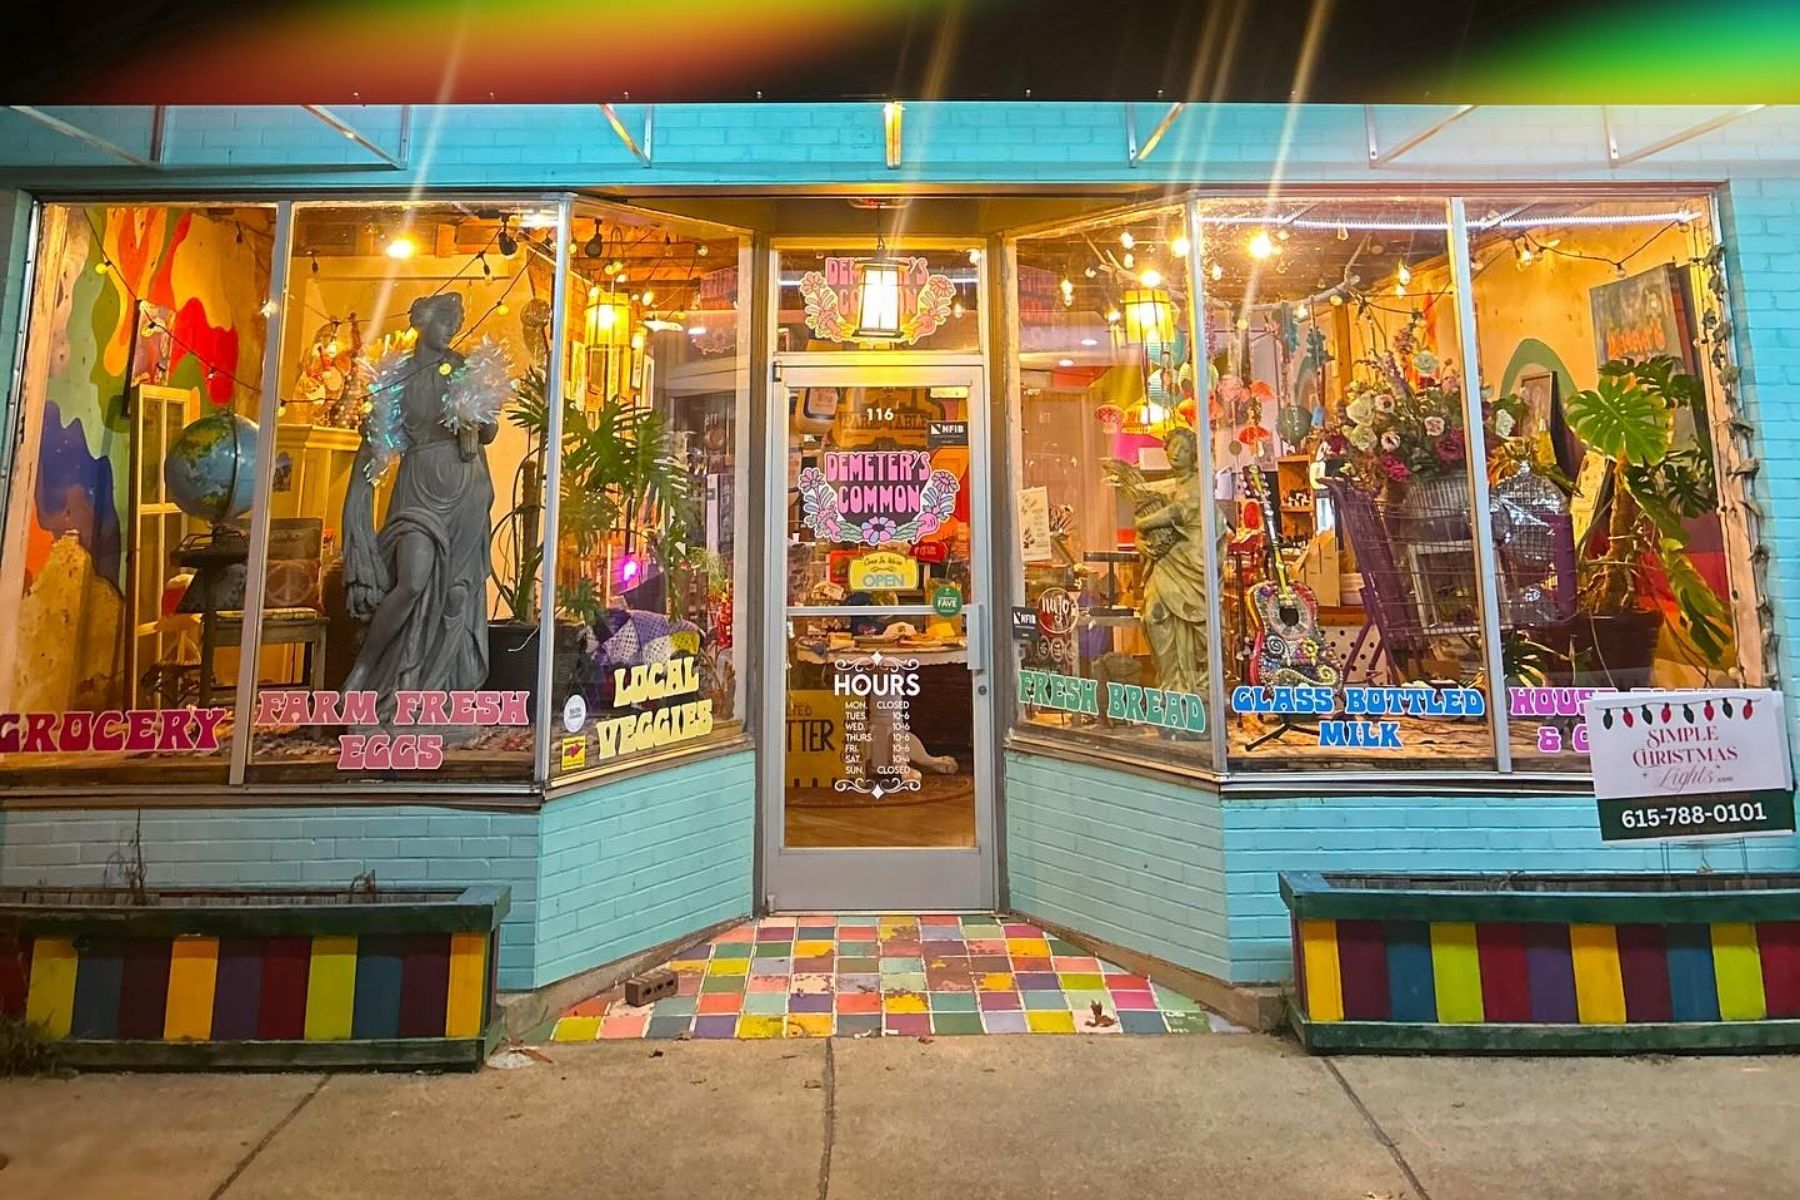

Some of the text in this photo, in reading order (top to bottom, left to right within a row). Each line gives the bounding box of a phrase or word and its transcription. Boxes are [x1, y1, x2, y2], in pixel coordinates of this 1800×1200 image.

[866, 408, 894, 421] 116
[825, 453, 931, 482] DEMETER'S
[837, 484, 920, 513] COMMON
[863, 574, 905, 588] OPEN
[937, 599, 957, 608] FAVE
[614, 656, 699, 707] LOCAL
[834, 674, 920, 696] HOURS
[256, 690, 531, 726] FARM FRESH
[845, 701, 910, 710] MON. CLOSED
[1019, 670, 1205, 733] FRESH BREAD
[1231, 686, 1486, 716] GLASS BOTTLED
[596, 698, 714, 760] VEGGIES
[893, 712, 910, 720] 10-6
[0, 708, 226, 752] GROCERY
[893, 734, 910, 742] 10-6
[1318, 721, 1402, 748] MILK
[1537, 726, 1561, 754] &
[1647, 726, 1719, 749] SIMPLE
[337, 734, 443, 770] EGGS
[893, 744, 910, 753] 10-6
[1633, 746, 1738, 768] CHRISTMAS
[877, 766, 911, 775] CLOSED
[1621, 802, 1767, 829] 615-788-0101
